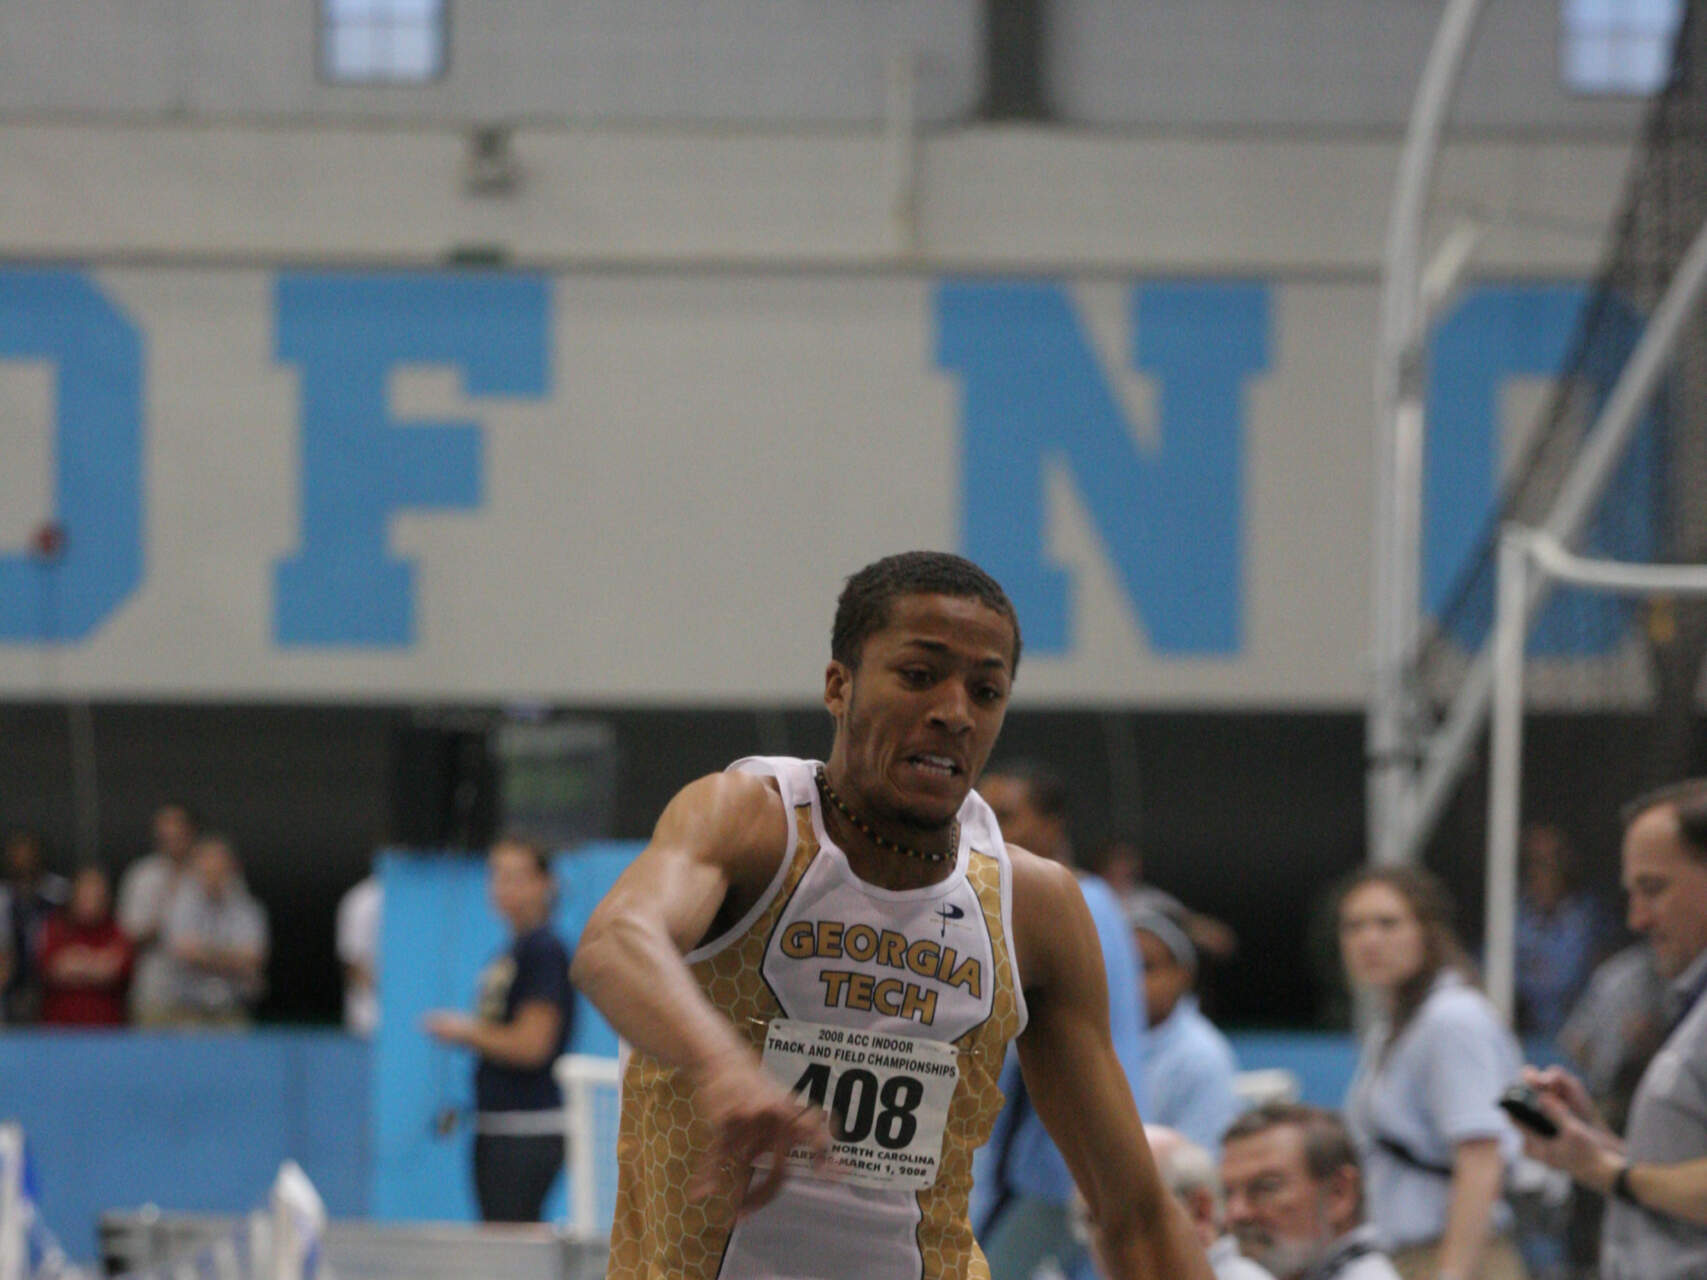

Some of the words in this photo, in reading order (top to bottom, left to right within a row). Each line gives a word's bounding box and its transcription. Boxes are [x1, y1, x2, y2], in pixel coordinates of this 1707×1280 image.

[780, 920, 983, 1000] GEORGIA
[818, 970, 939, 1026] TECH
[767, 1037, 805, 1055] TRACK
[808, 1045, 832, 1059] AND
[834, 1048, 866, 1064] FIELD
[867, 1053, 957, 1078] CHAMPIONSHIPS
[818, 1028, 844, 1043] 2008
[847, 1033, 870, 1047] ACC
[871, 1037, 914, 1054] INDOOR
[831, 1143, 874, 1159] NORTH
[877, 1150, 936, 1166] CAROLINA
